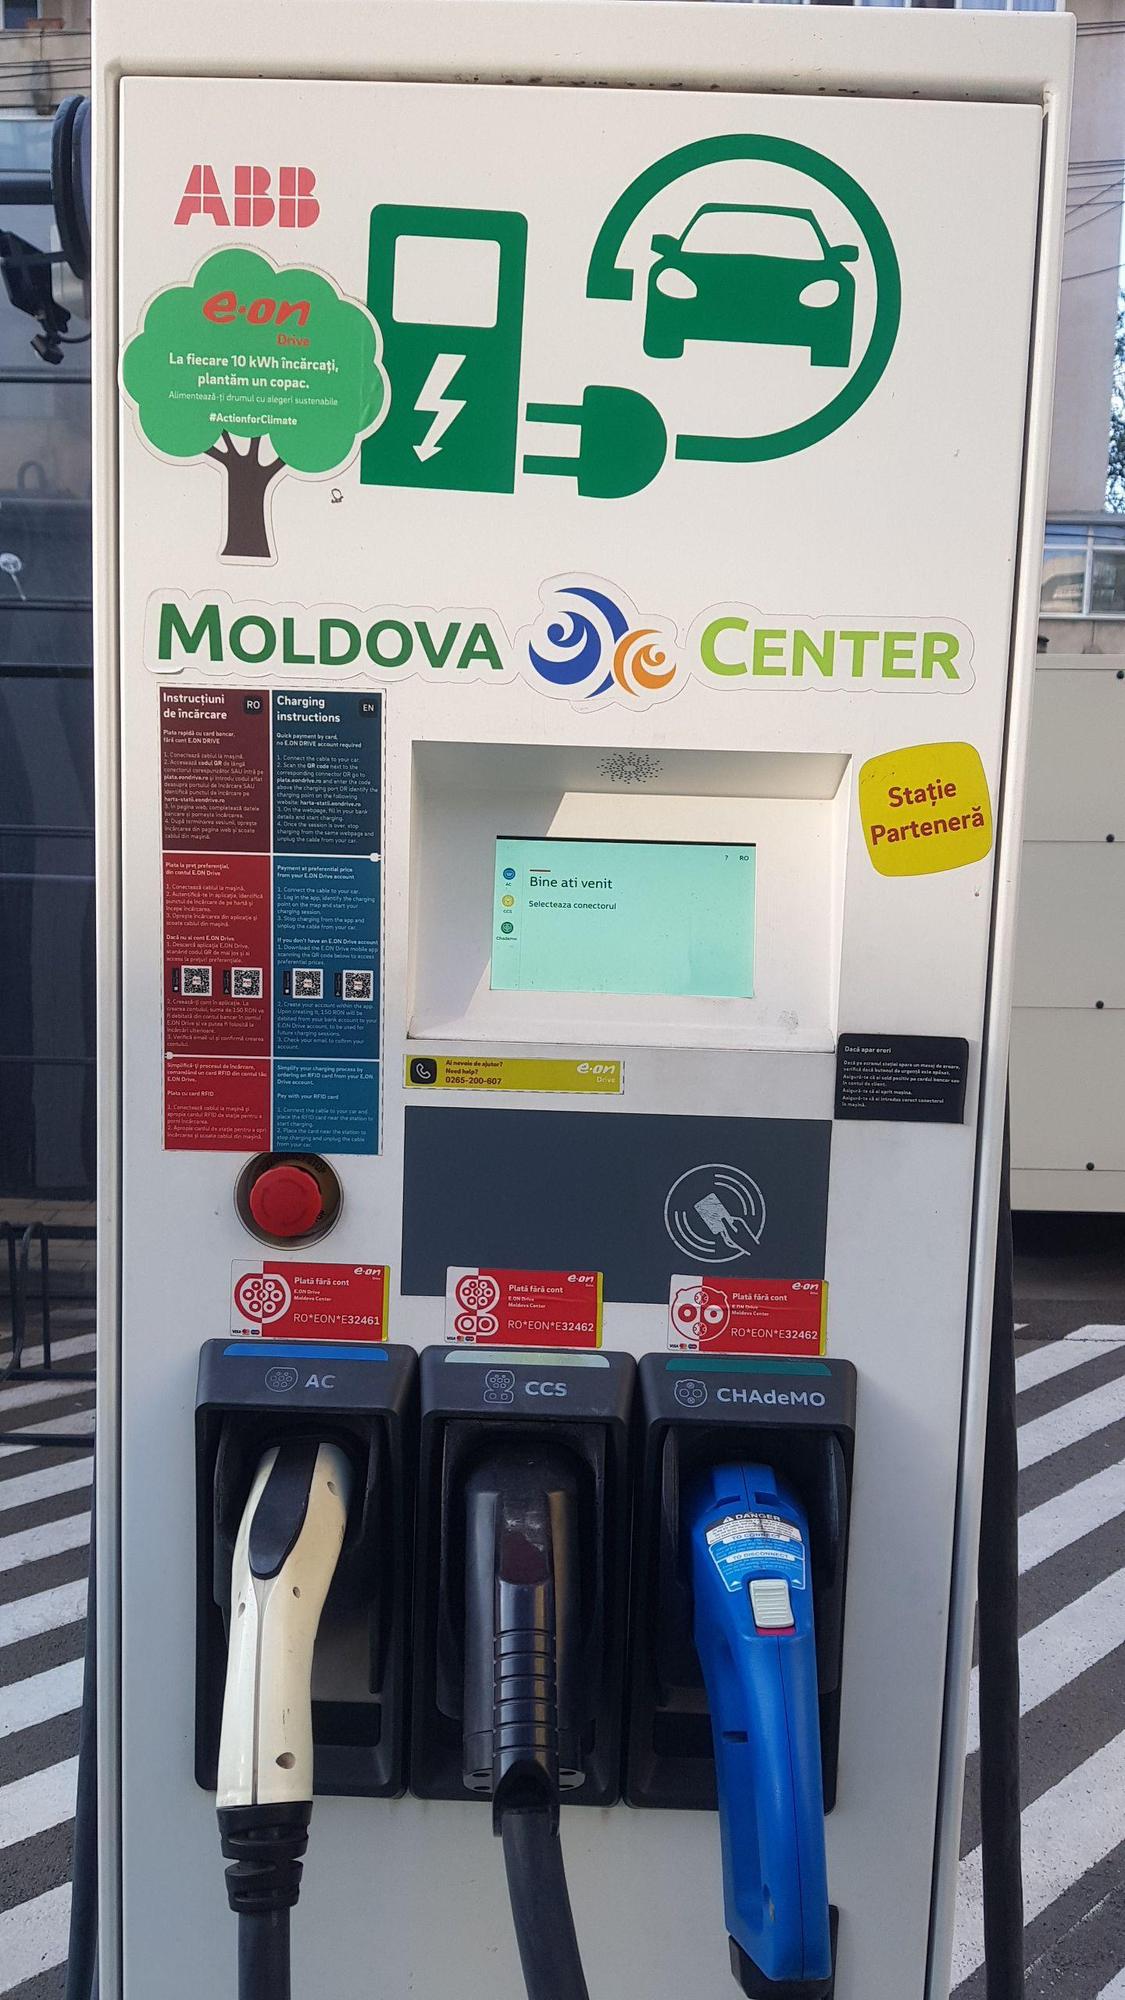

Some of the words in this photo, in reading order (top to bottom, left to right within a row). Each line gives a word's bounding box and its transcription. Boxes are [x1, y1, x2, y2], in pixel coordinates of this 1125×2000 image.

[174, 164, 320, 228] ABB
[276, 334, 309, 346] Drive
[169, 352, 183, 364] La
[186, 353, 228, 366] fiecare
[231, 355, 246, 366] 10
[249, 356, 279, 368] kWh
[198, 372, 249, 387] plantăm
[252, 377, 268, 386] un
[270, 378, 309, 390] copac.
[226, 393, 254, 403] drumul
[267, 394, 293, 405] alegeri
[295, 396, 338, 406] sustenabile
[209, 413, 297, 425] #ActionforClimate
[158, 602, 504, 670] MOLDOVA
[700, 616, 960, 679] CENTER
[163, 693, 224, 706] Instrucțiuni
[247, 700, 260, 709] RO
[277, 696, 325, 709] Charging
[164, 708, 176, 718] de
[178, 708, 227, 720] încărcare
[277, 711, 340, 722] instructions
[870, 806, 984, 846] Parteneră
[530, 876, 558, 888] Bine
[561, 877, 578, 888] ati
[581, 877, 613, 889] venit
[528, 900, 572, 909] Selecteaza
[574, 901, 616, 910] conectorul
[294, 1276, 314, 1285] Plată
[316, 1278, 331, 1286] fără
[508, 1284, 529, 1292] Plată
[304, 1374, 336, 1389] AC
[525, 1381, 568, 1397] CCS
[716, 1388, 826, 1407] CHAdeMO
[736, 1513, 781, 1521] DANGER
